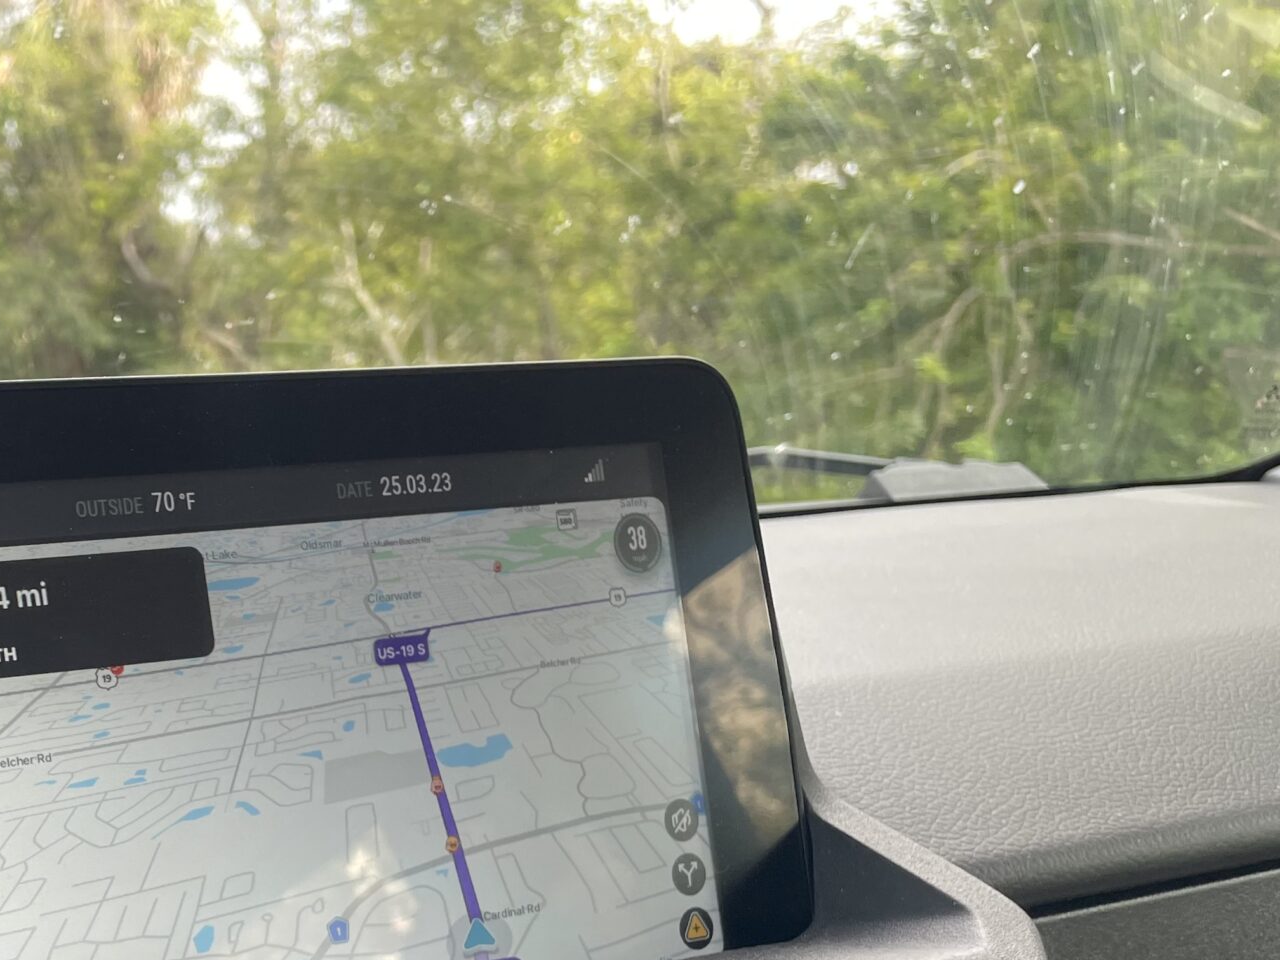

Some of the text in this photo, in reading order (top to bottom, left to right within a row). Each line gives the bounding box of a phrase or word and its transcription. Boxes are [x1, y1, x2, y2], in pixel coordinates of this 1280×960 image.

[336, 473, 452, 499] DATE 25.03.23
[76, 497, 144, 517] OUTSIDE
[151, 491, 175, 512] 70
[300, 539, 342, 551] Oldsmar
[627, 526, 647, 551] 38
[16, 581, 49, 608] mi
[367, 590, 423, 604] Clearwater
[377, 643, 426, 659] US-19 S
[102, 674, 111, 683] 19
[35, 754, 52, 764] Rd
[484, 905, 541, 921] Cardinal Rd
